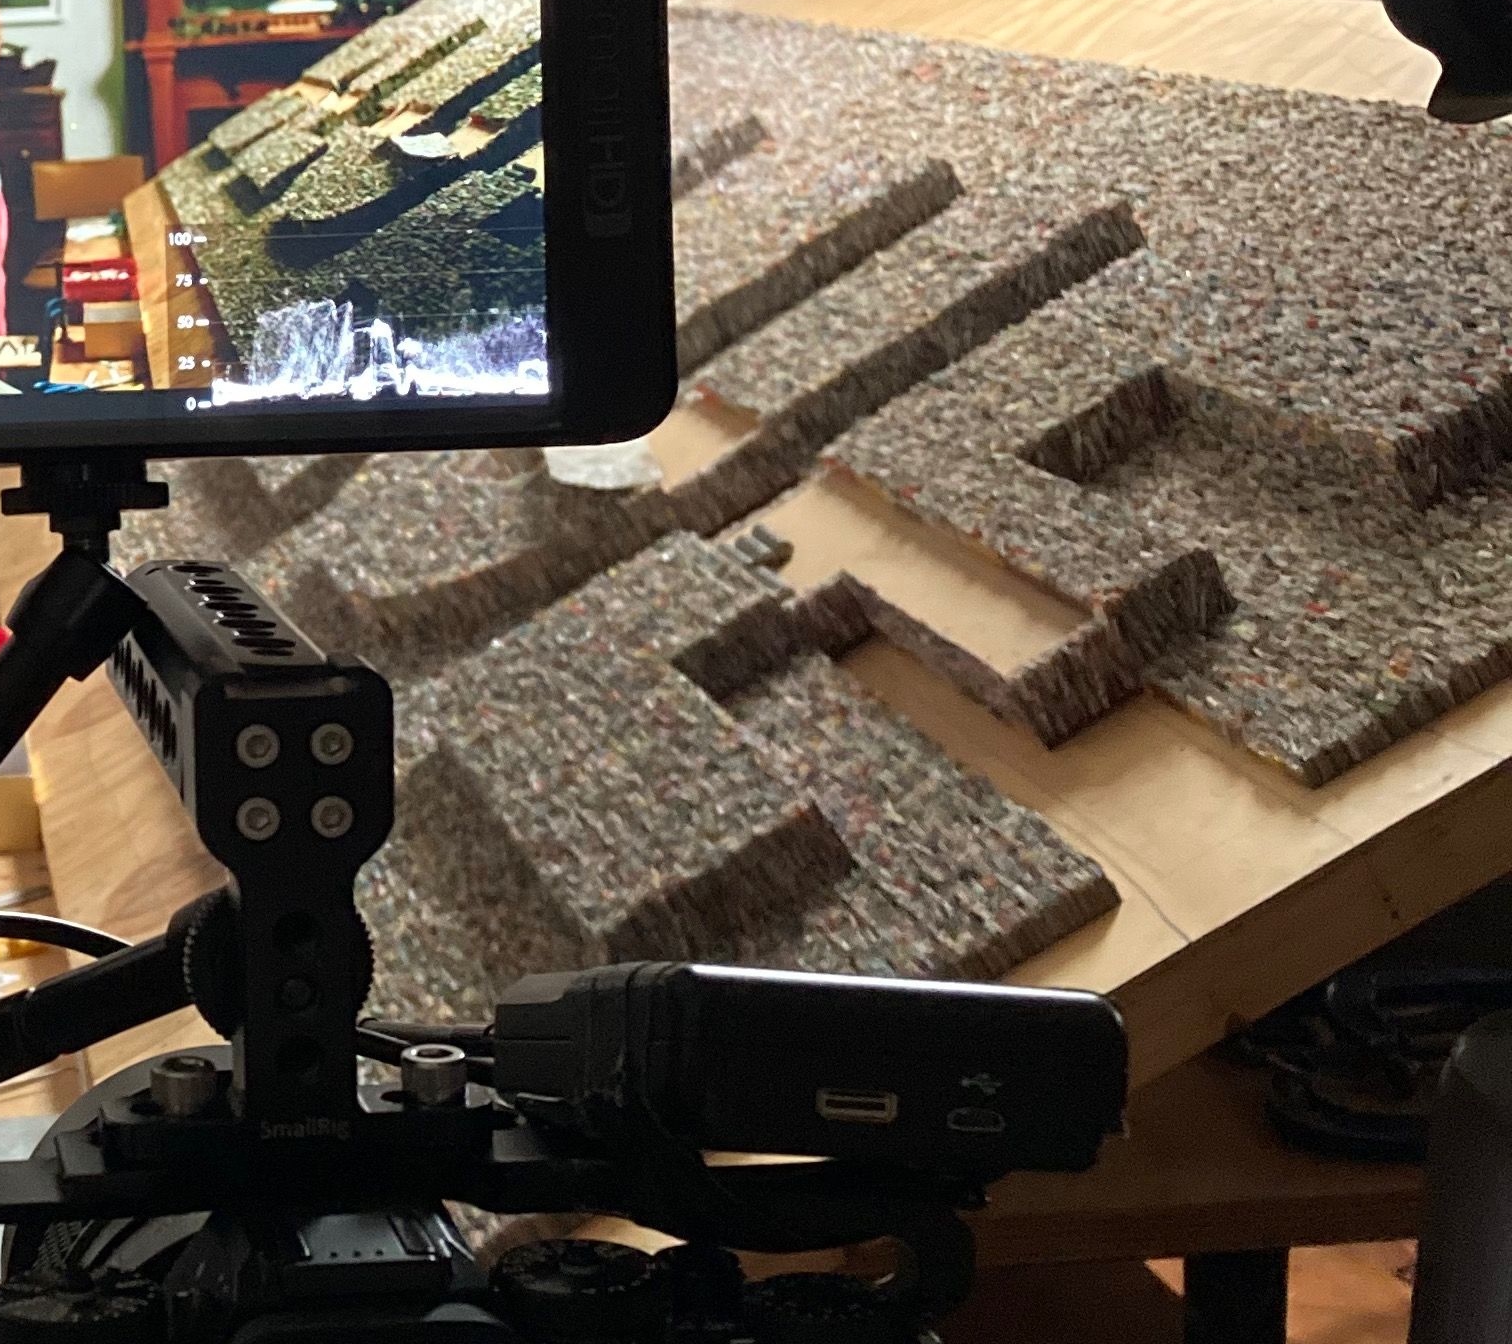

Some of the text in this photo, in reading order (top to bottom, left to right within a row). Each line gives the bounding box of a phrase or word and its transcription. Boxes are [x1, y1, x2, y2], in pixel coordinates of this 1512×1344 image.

[168, 231, 192, 247] 100
[175, 273, 193, 288] 75
[176, 314, 194, 329] 50
[177, 355, 196, 371] 25
[185, 396, 197, 411] 0
